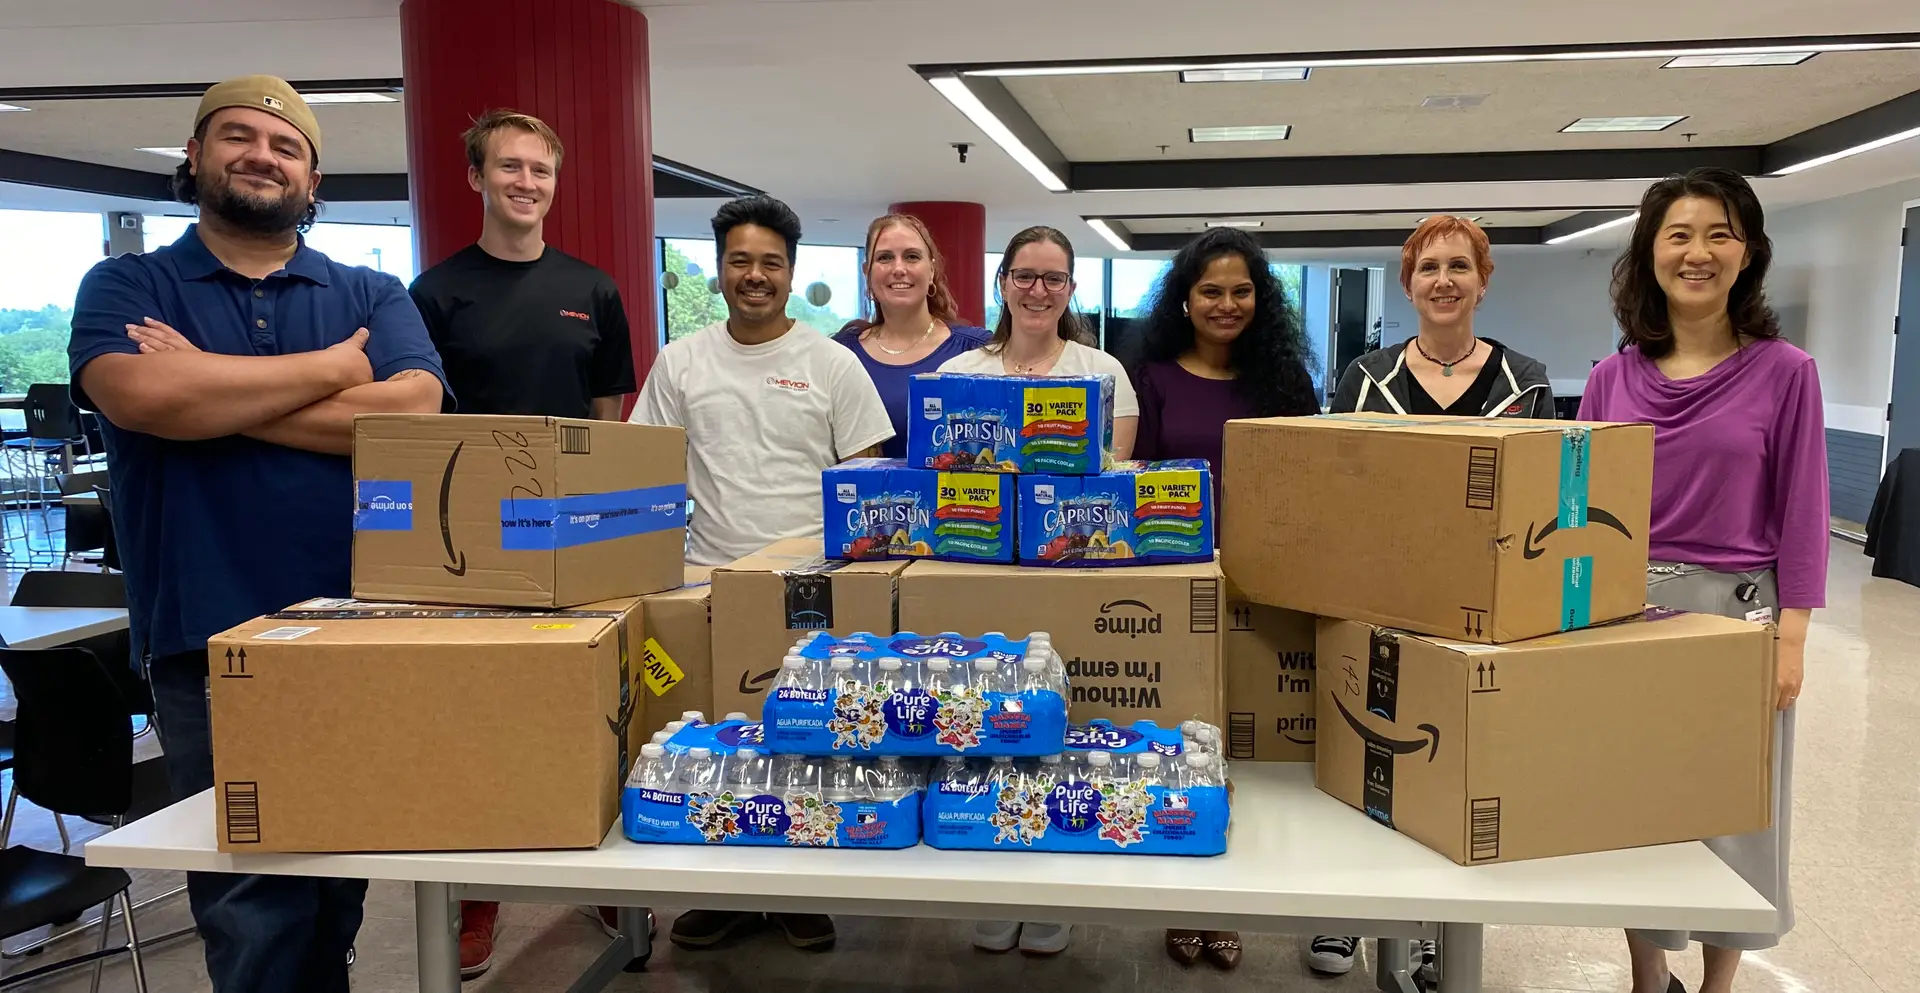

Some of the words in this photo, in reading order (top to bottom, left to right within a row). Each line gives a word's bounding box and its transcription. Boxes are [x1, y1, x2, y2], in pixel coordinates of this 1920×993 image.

[775, 379, 809, 388] MEVION
[1026, 402, 1044, 413] 30
[941, 487, 956, 497] 30
[1138, 485, 1156, 495] 30
[371, 501, 395, 511] prime
[664, 502, 676, 511] prime
[518, 518, 531, 527] it's
[585, 513, 600, 524] prime
[1094, 614, 1162, 639] prime
[997, 654, 1015, 663] 24
[1277, 651, 1316, 670] Wit
[1125, 662, 1160, 682] I'm
[1277, 674, 1310, 693] I'm
[779, 690, 789, 698] 24
[790, 690, 827, 700] BOTELLAS
[1072, 686, 1162, 708] Withou
[892, 693, 930, 710] Pure
[897, 705, 925, 722] Life
[1154, 745, 1176, 756] 24
[941, 783, 950, 791] 24
[642, 791, 651, 799] 24
[652, 792, 682, 803] BOTTLES
[1055, 786, 1093, 802] Pure
[745, 801, 782, 816] Pure
[1060, 800, 1089, 816] Life
[749, 814, 779, 827] Life
[954, 812, 985, 821] PURIFICADA
